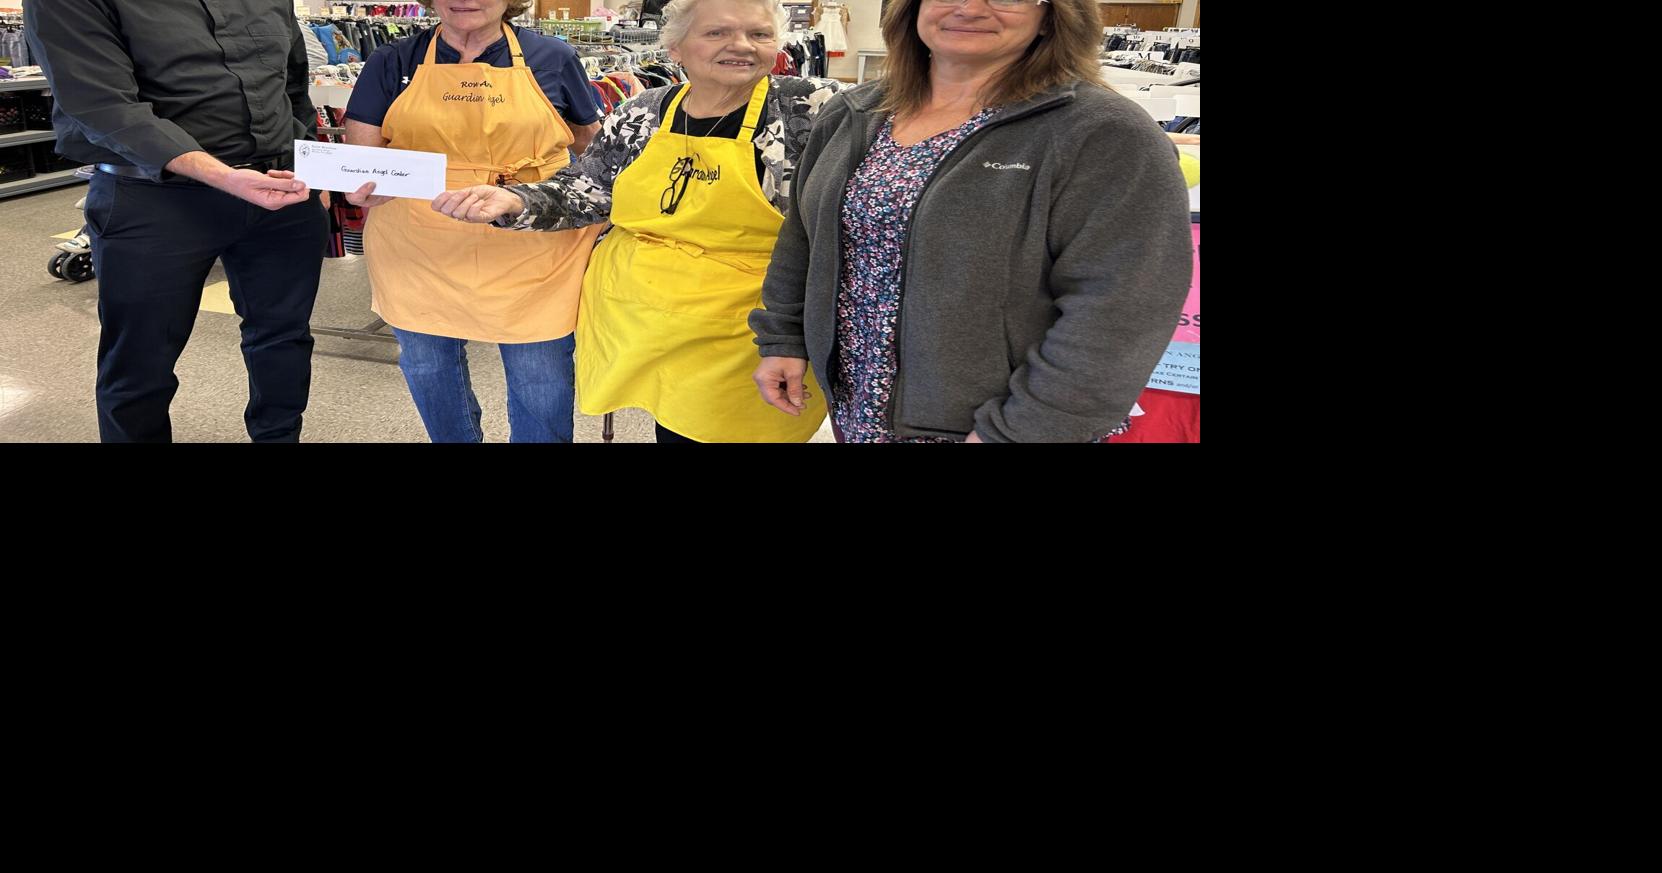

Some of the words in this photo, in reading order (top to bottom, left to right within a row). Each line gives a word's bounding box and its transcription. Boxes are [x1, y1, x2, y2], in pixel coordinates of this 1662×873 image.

[340, 165, 370, 175] Guardian
[372, 168, 389, 177] Angel
[992, 162, 1030, 170] Columbia
